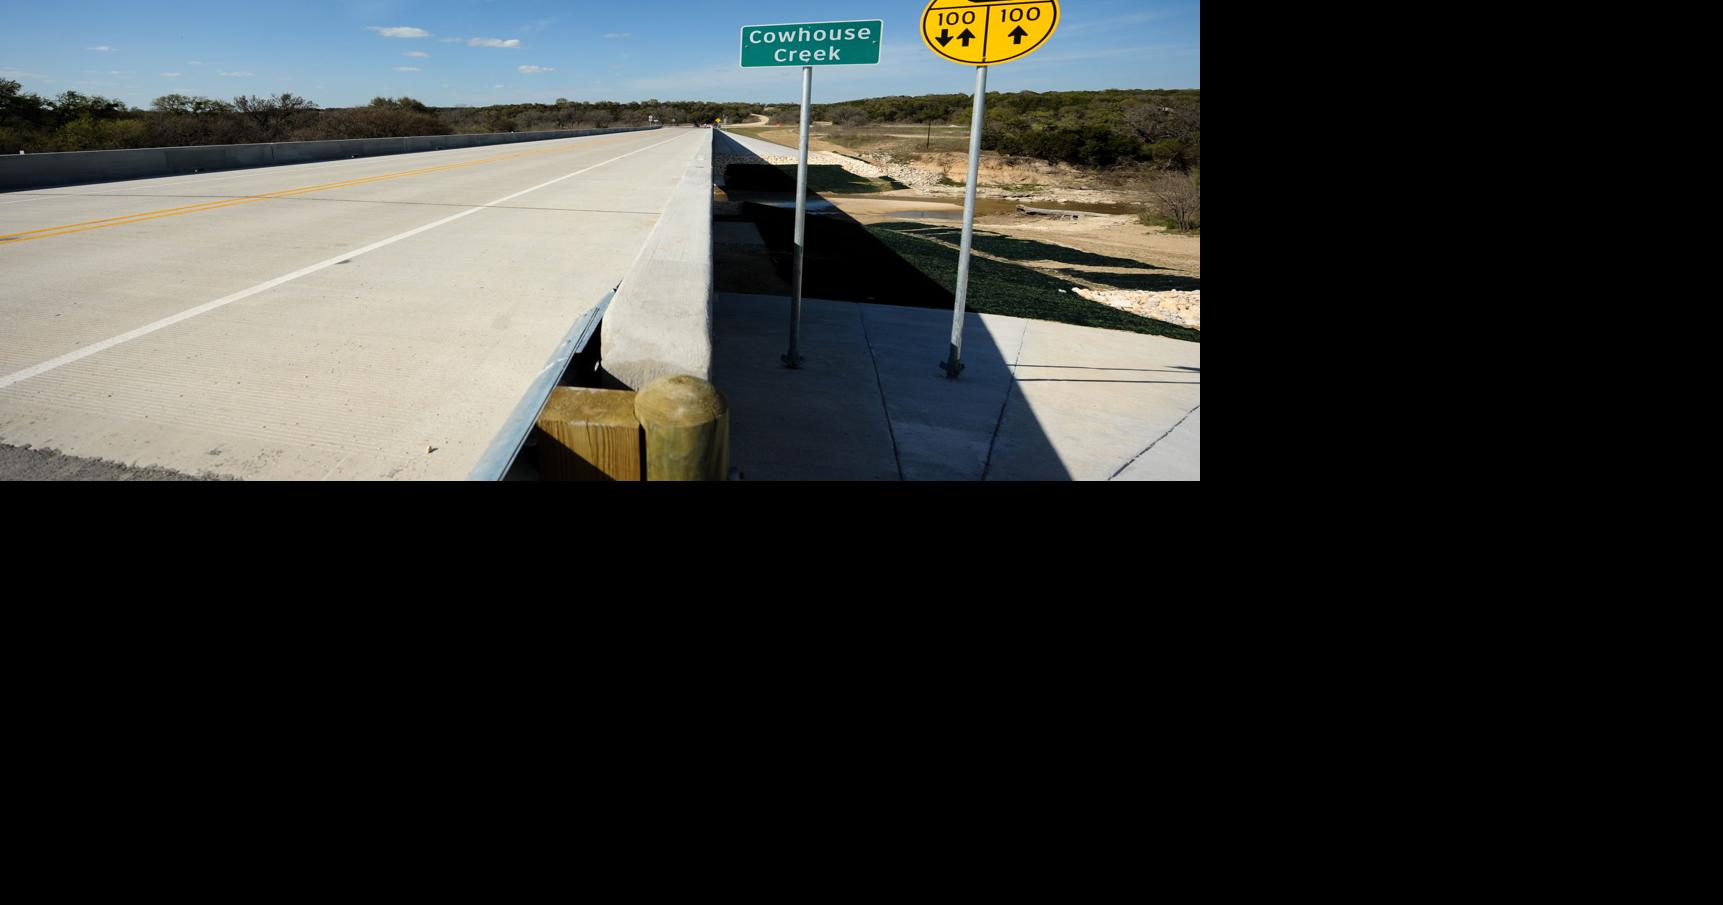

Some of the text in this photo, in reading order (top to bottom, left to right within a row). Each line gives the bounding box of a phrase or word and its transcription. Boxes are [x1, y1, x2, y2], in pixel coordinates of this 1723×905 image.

[938, 11, 976, 26] 100
[1001, 7, 1041, 23] 100
[749, 27, 871, 44] Cowhouse
[774, 46, 841, 62] Creek
